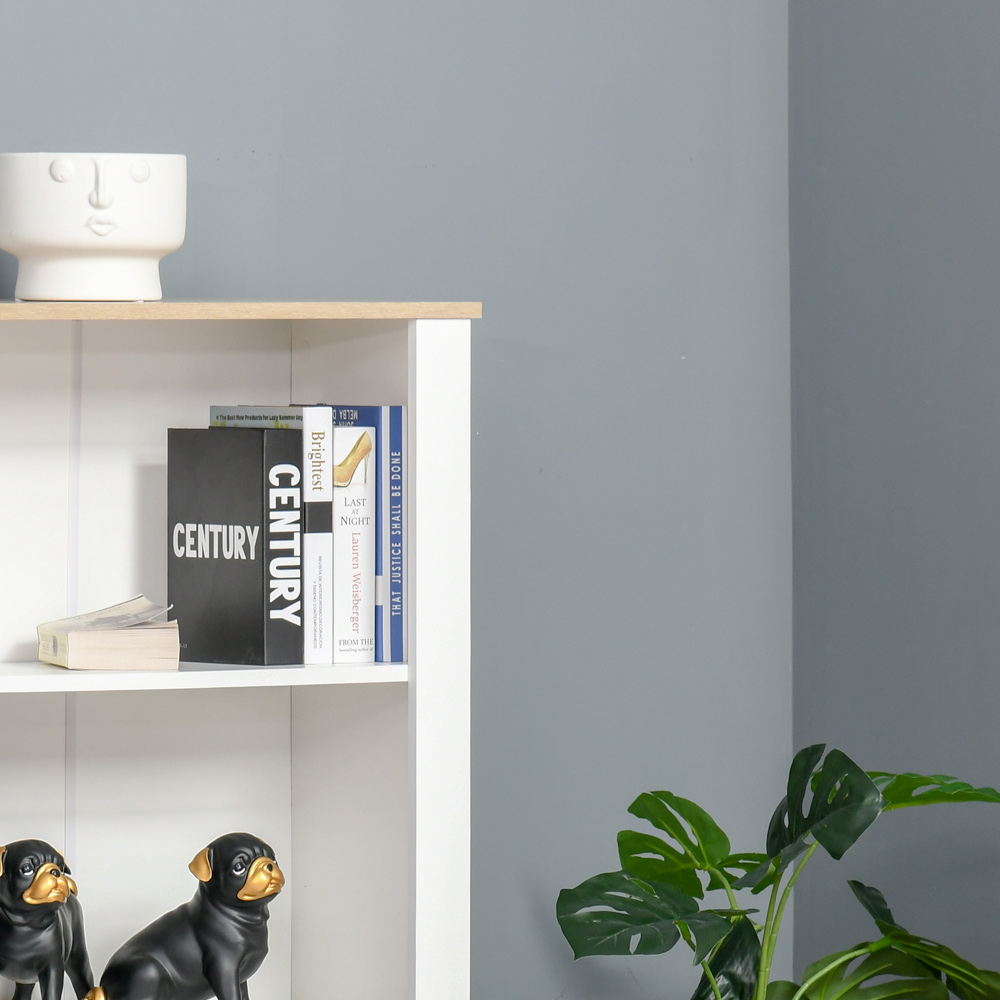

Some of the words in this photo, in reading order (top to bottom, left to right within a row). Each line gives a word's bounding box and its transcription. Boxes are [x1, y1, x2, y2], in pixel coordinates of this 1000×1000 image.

[339, 410, 358, 420] MELBA
[307, 432, 325, 491] Brightest
[392, 451, 401, 475] DONE
[344, 497, 367, 507] LAST
[392, 485, 401, 497] BE
[340, 516, 370, 526] NIGHT
[392, 504, 401, 535] SHALL
[173, 523, 259, 560] CENTURY
[269, 463, 301, 626] CENTURY
[351, 532, 361, 569] Lauren
[392, 542, 401, 583] JUSTICE
[350, 572, 361, 633] Weisberger
[392, 591, 401, 616] THAT
